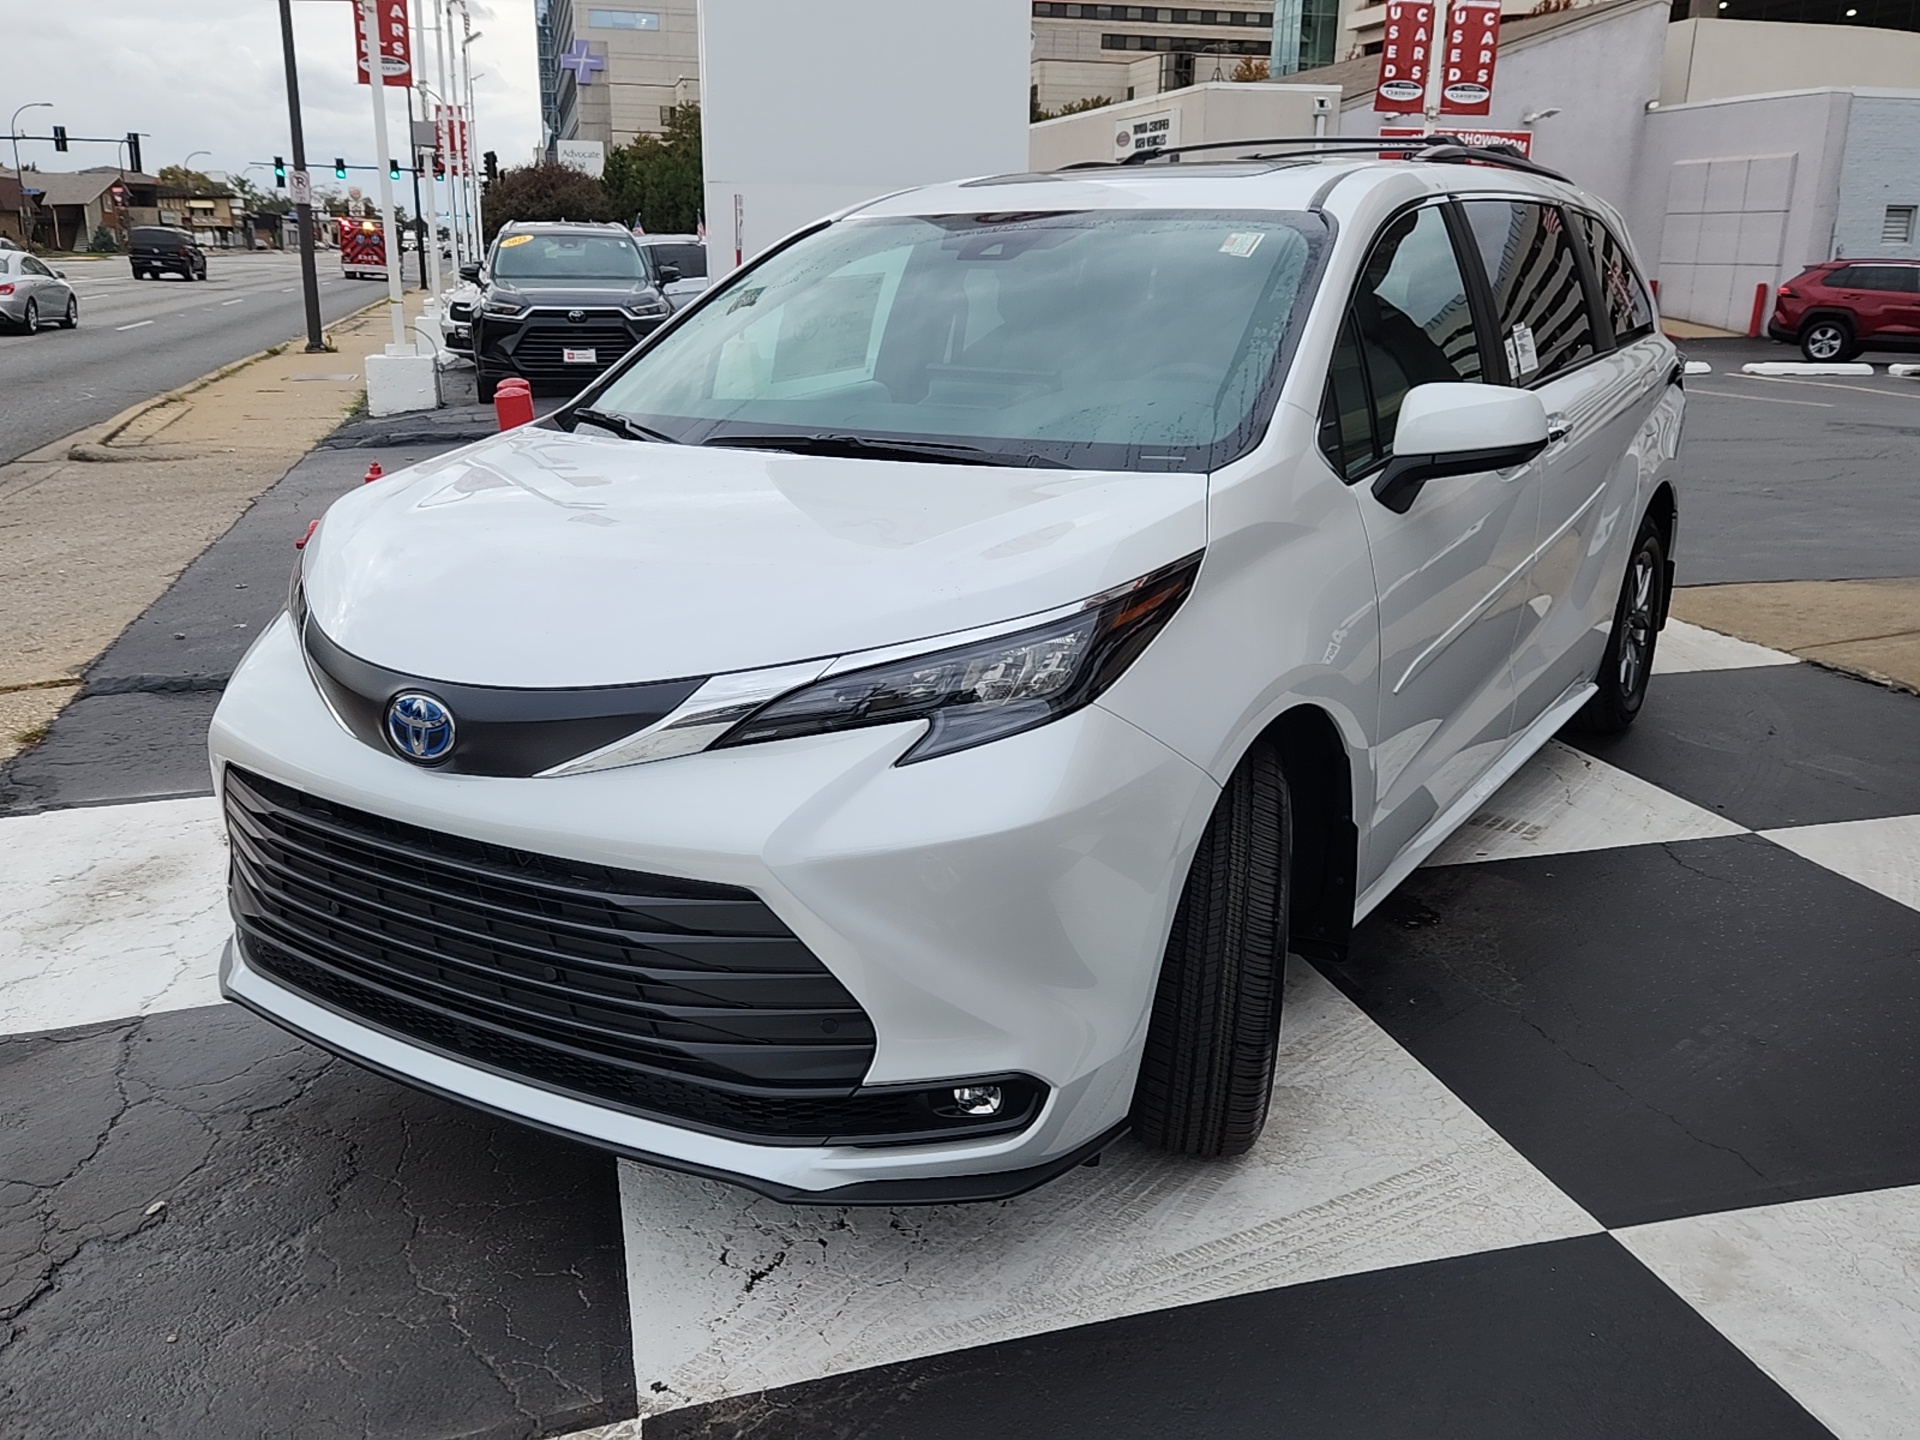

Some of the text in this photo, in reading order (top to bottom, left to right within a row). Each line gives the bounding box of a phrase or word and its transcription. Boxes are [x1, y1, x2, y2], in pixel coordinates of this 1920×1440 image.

[390, 4, 405, 55] ARS
[1384, 6, 1402, 78] USED
[1411, 8, 1428, 80] CARS
[1448, 10, 1467, 82] USED
[1477, 12, 1496, 83] CARS
[562, 149, 600, 159] Advocate
